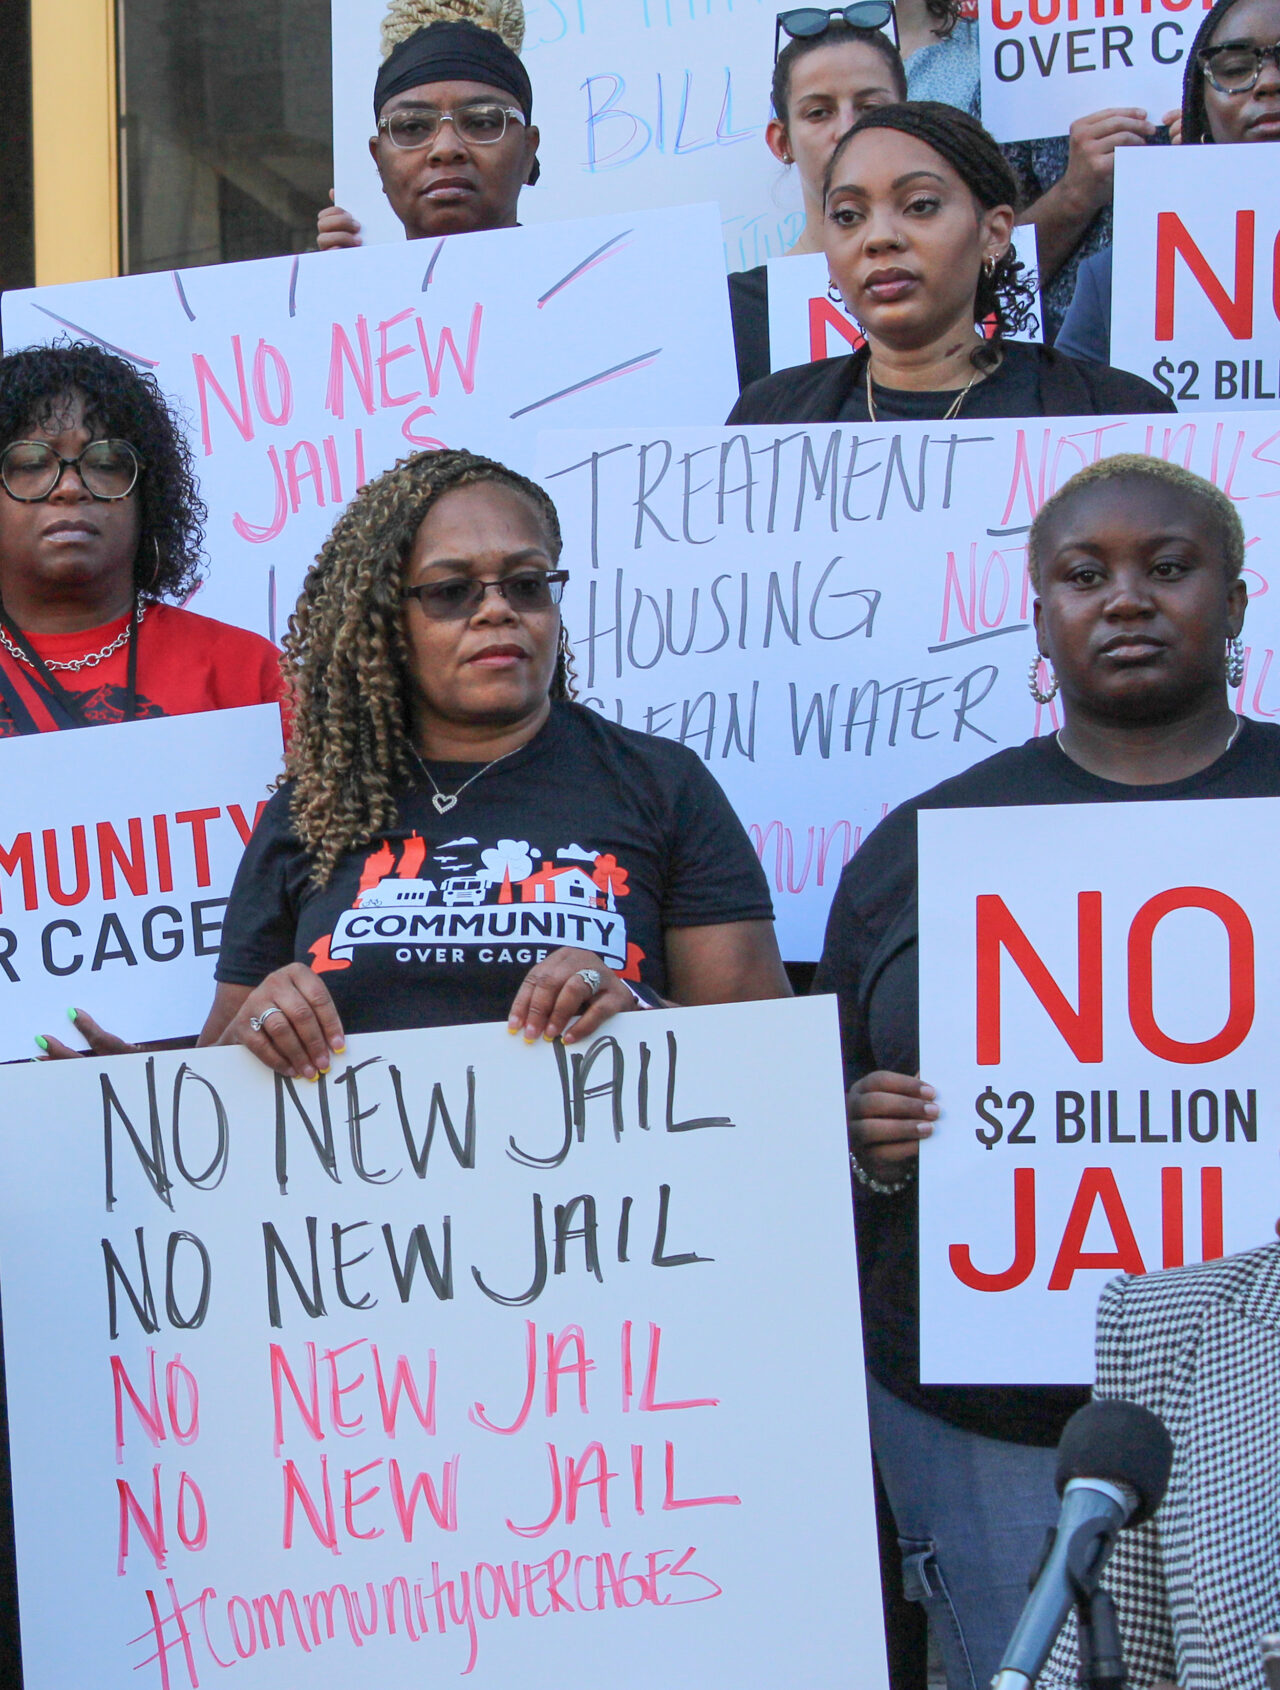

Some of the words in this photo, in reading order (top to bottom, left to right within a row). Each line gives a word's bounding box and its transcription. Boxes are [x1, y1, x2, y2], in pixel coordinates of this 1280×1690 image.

[994, 25, 1134, 82] OVER
[579, 66, 766, 174] BILL
[192, 335, 294, 457] NO
[325, 302, 484, 420] NEW
[1153, 356, 1200, 400] $2
[1215, 359, 1280, 400] BIL
[544, 424, 995, 569] TREATMENT
[573, 557, 882, 688] HOUSING
[788, 664, 999, 761] WATER
[345, 911, 615, 947] COMMUNITY
[395, 948, 466, 963] OVER
[976, 886, 1255, 1065] NO
[100, 1056, 229, 1212] NO
[274, 1056, 475, 1196] NEW
[506, 1030, 736, 1170] JAIL
[975, 1085, 1036, 1150] $2
[1056, 1088, 1258, 1143] BILLION
[101, 1226, 211, 1341] NO
[263, 1215, 453, 1329] NEW
[470, 1183, 716, 1307] JAIL
[110, 1346, 200, 1464] NO
[270, 1338, 438, 1457] NEW
[468, 1320, 721, 1436] JAIL
[116, 1462, 209, 1576] NO
[282, 1453, 461, 1556] NEW
[505, 1440, 742, 1540] JAIL
